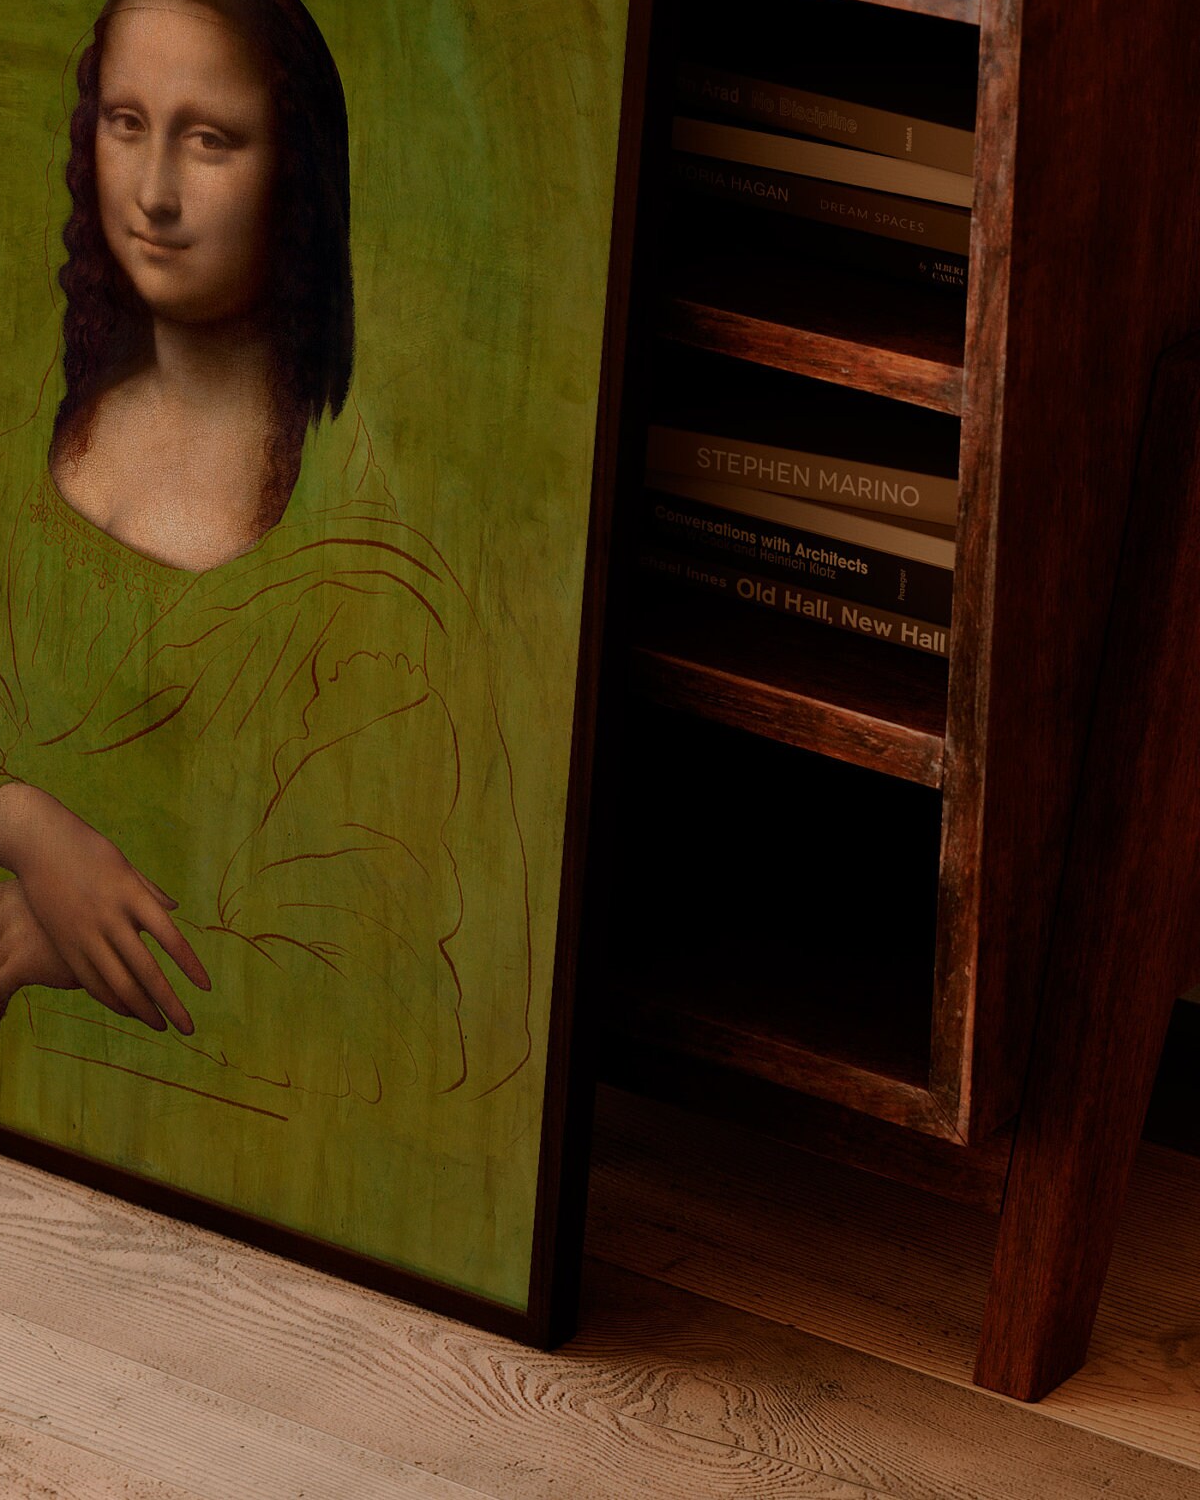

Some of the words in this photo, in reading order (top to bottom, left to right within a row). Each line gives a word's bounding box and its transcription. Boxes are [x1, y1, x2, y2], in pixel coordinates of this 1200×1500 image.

[731, 174, 789, 203] HAGAN
[820, 199, 868, 220] DREAM
[873, 212, 925, 234] SPACES
[696, 447, 810, 488] STEPHEN
[818, 469, 920, 508] MARINO
[654, 504, 757, 545] Conversations
[761, 534, 791, 554] with
[794, 541, 869, 576] Architects
[759, 549, 806, 573] Heinrich
[809, 560, 837, 580] Klotz
[686, 565, 727, 588] Innes
[736, 577, 776, 606] Old
[784, 592, 833, 625] Hall,
[841, 606, 892, 637] New
[901, 623, 946, 654] Hall
